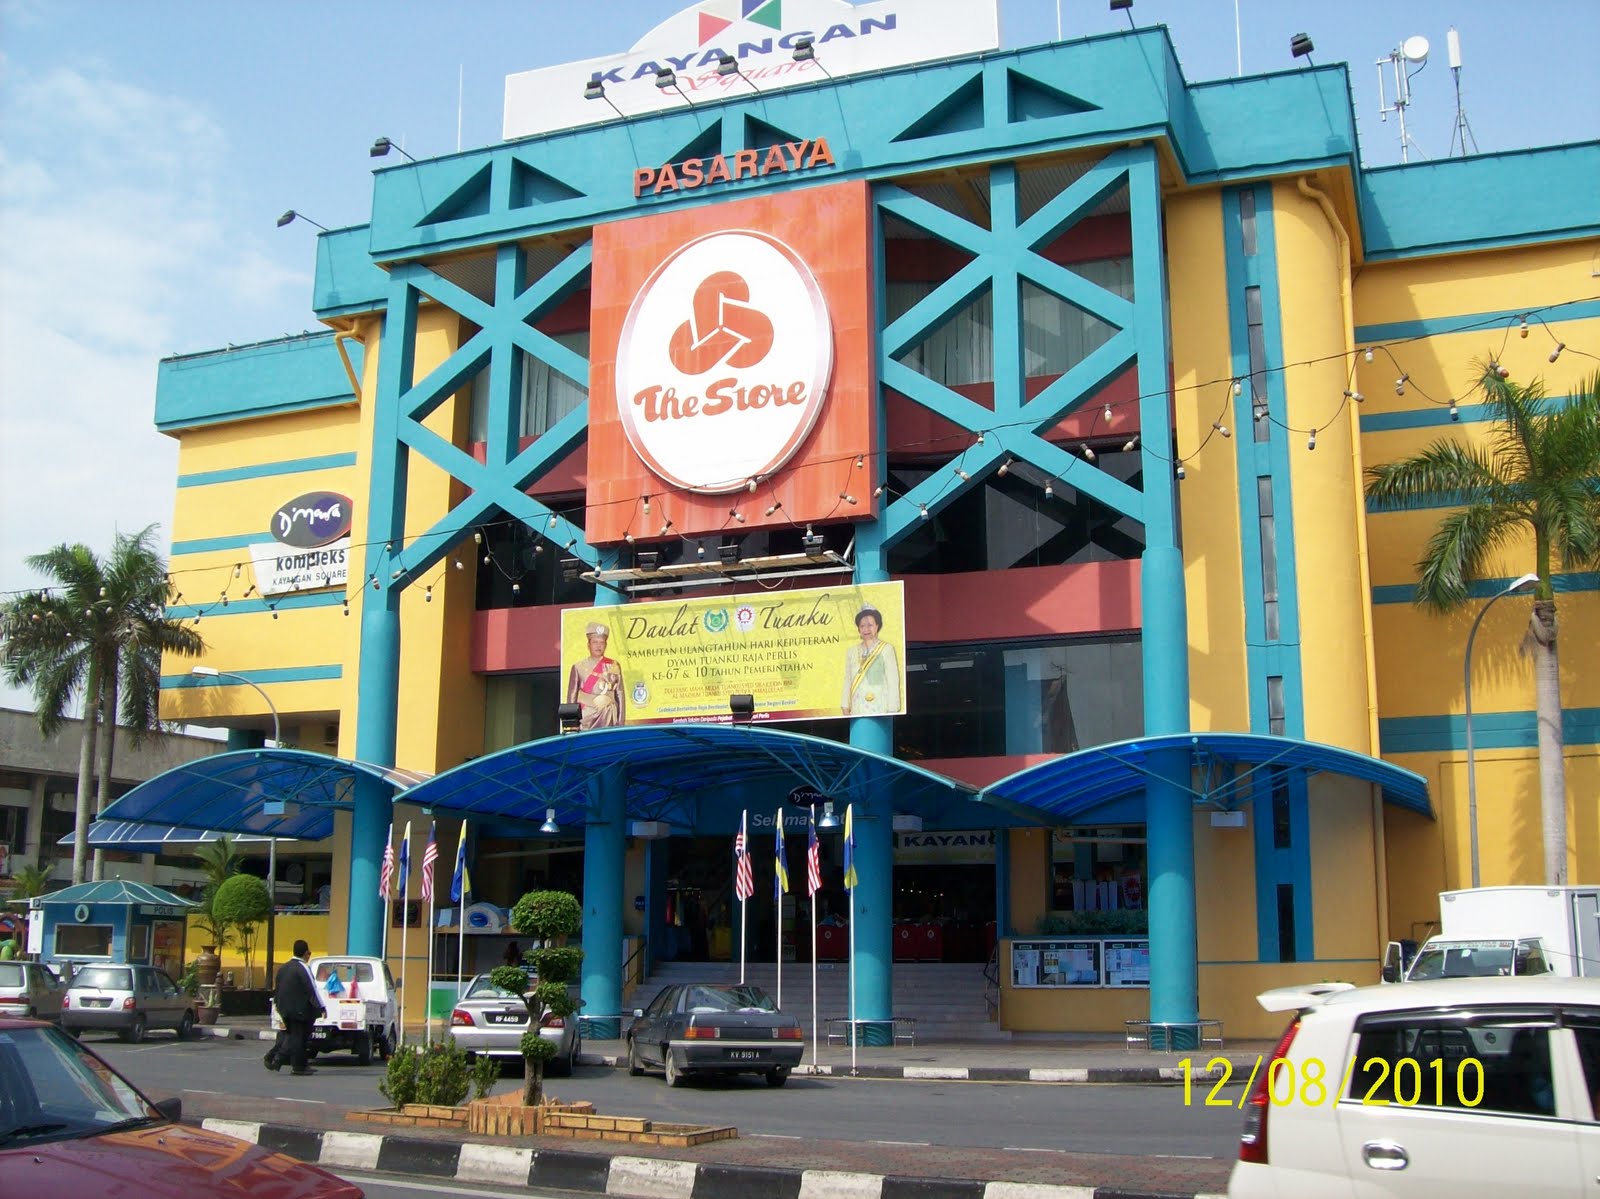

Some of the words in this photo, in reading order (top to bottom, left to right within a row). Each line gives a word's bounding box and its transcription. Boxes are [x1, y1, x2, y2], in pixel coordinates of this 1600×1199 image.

[591, 13, 897, 84] KAYANGAN
[633, 137, 835, 197] PASARAYA
[633, 384, 700, 422] The
[702, 377, 807, 416] Store
[626, 603, 699, 640] Daulat
[759, 593, 834, 629] Tuanku
[627, 647, 677, 659] SAMBUTAN
[679, 642, 747, 655] ULANGTAHUN
[750, 639, 774, 650] HARI
[776, 635, 840, 648] KEPUTERAAN
[667, 658, 697, 668] DYMM
[700, 654, 740, 665] TUANKU
[742, 653, 764, 663] RAJA
[766, 650, 798, 660] PERLIS
[682, 670, 690, 678] &
[695, 666, 708, 677] 10
[710, 667, 741, 677] TAHUN
[743, 662, 814, 675] PEMERINTAHAN
[154, 906, 174, 915] POLIS
